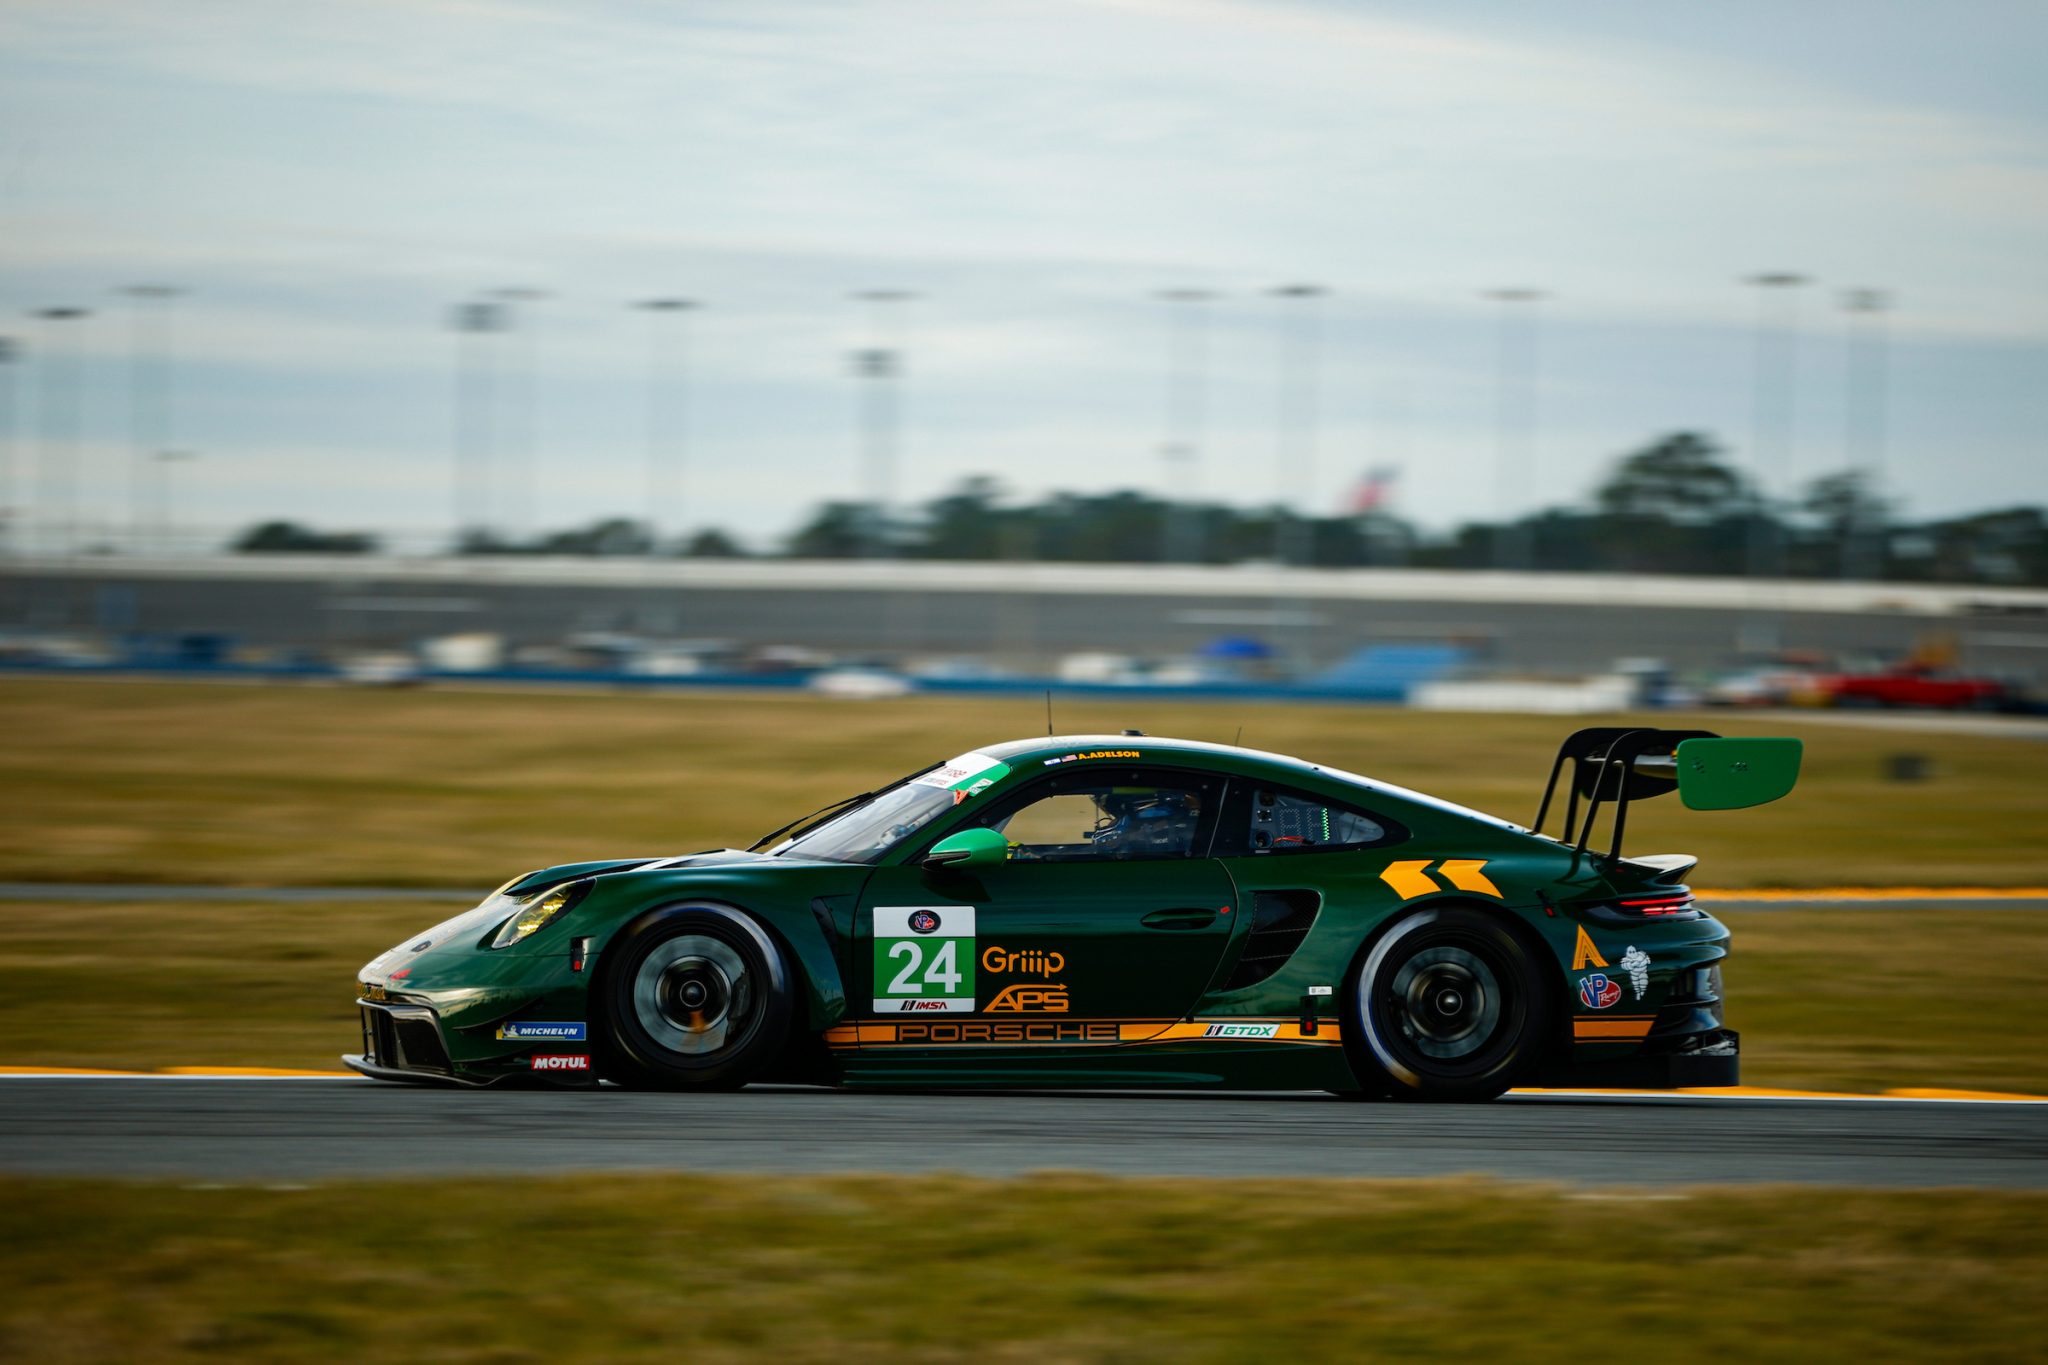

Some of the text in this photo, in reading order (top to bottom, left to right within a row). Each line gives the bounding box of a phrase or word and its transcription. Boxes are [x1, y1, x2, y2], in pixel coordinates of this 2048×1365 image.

[1078, 751, 1140, 760] A.ADELSON
[887, 940, 962, 994] 24
[982, 946, 1065, 978] Griiip
[1580, 973, 1609, 1008] VP
[982, 984, 1069, 1012] APS
[915, 1001, 948, 1010] IMSA
[520, 1027, 578, 1036] MICHELIN
[899, 1024, 1117, 1041] PORSCHE
[1223, 1026, 1274, 1036] GTDX
[533, 1057, 587, 1069] MOTUL
